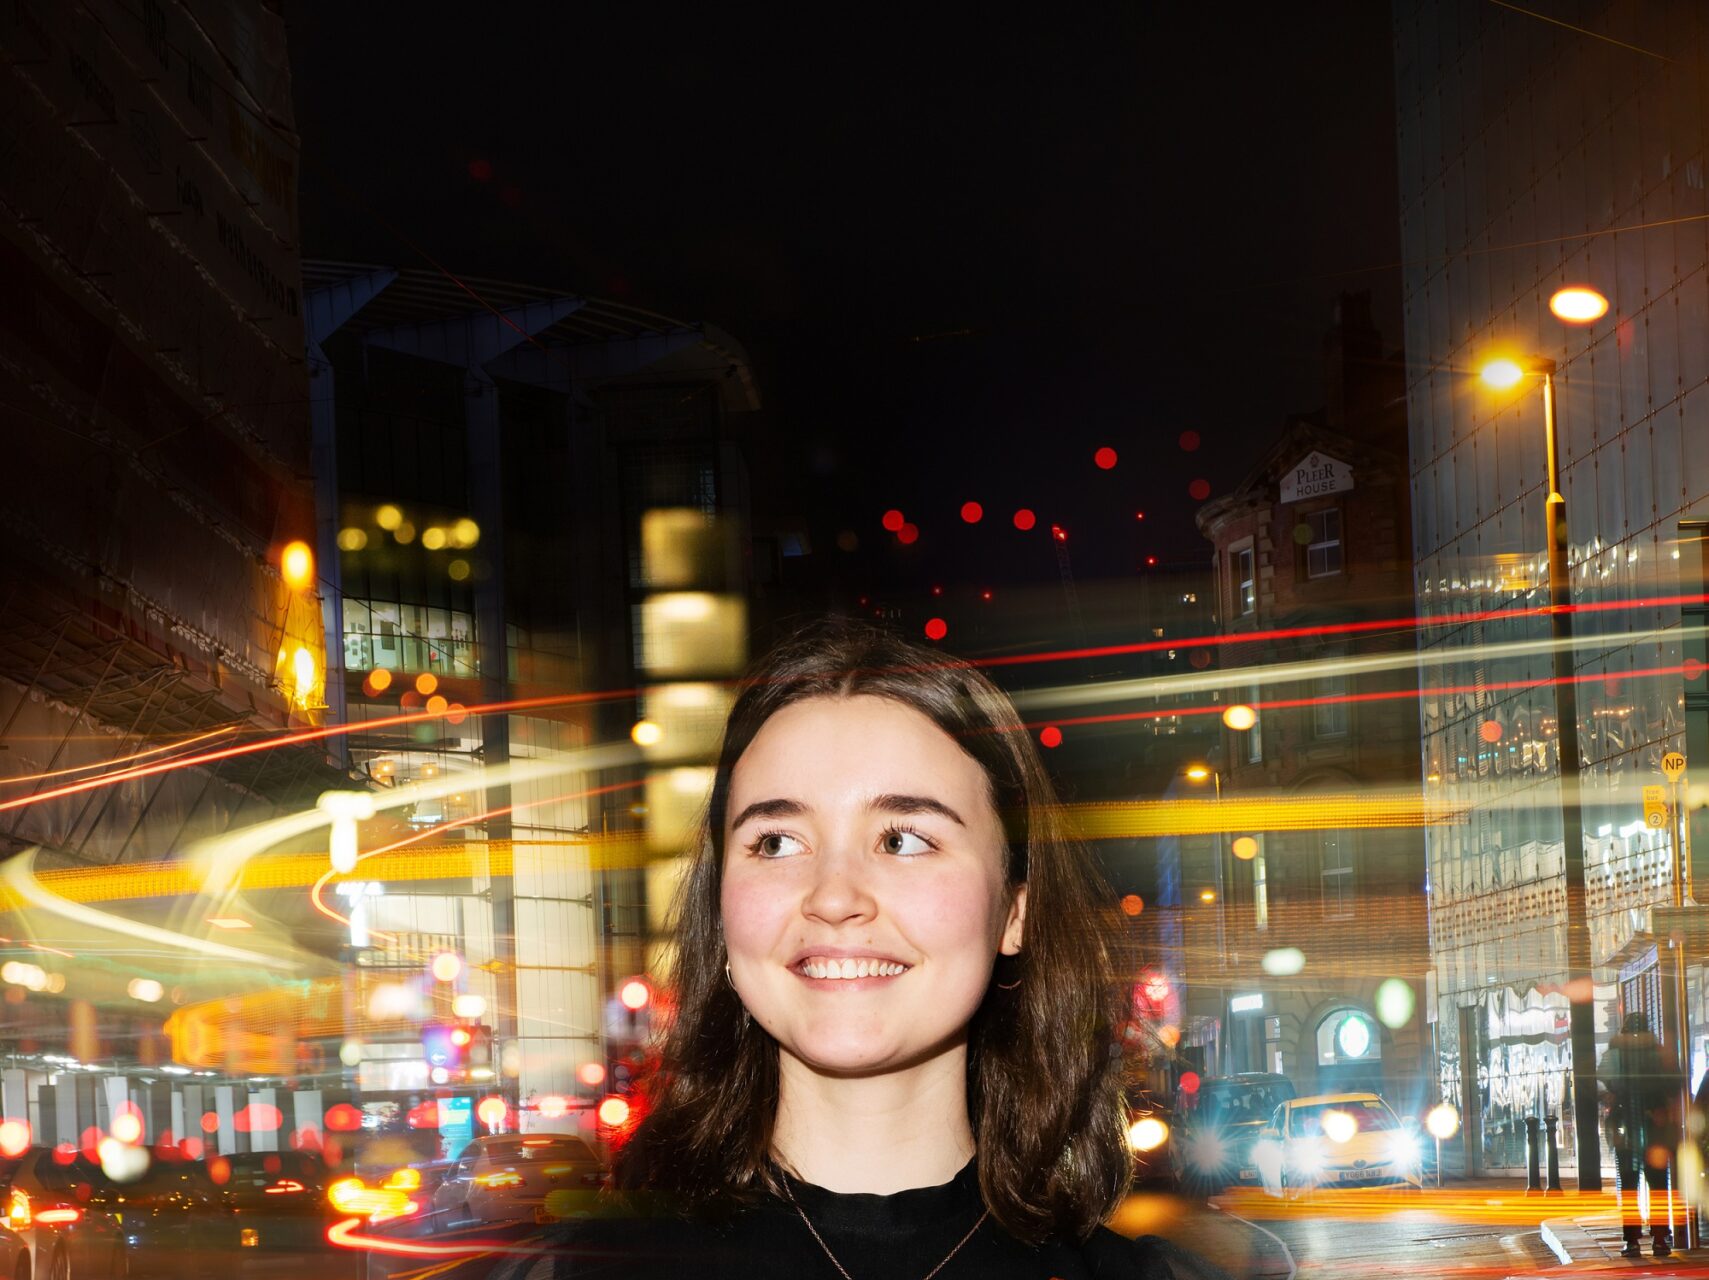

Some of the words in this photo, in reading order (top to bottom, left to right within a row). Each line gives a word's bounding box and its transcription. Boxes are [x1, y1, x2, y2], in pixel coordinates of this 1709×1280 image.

[1296, 480, 1336, 497] HOUSE
[1665, 758, 1684, 770] NP
[1652, 814, 1660, 825] 2
